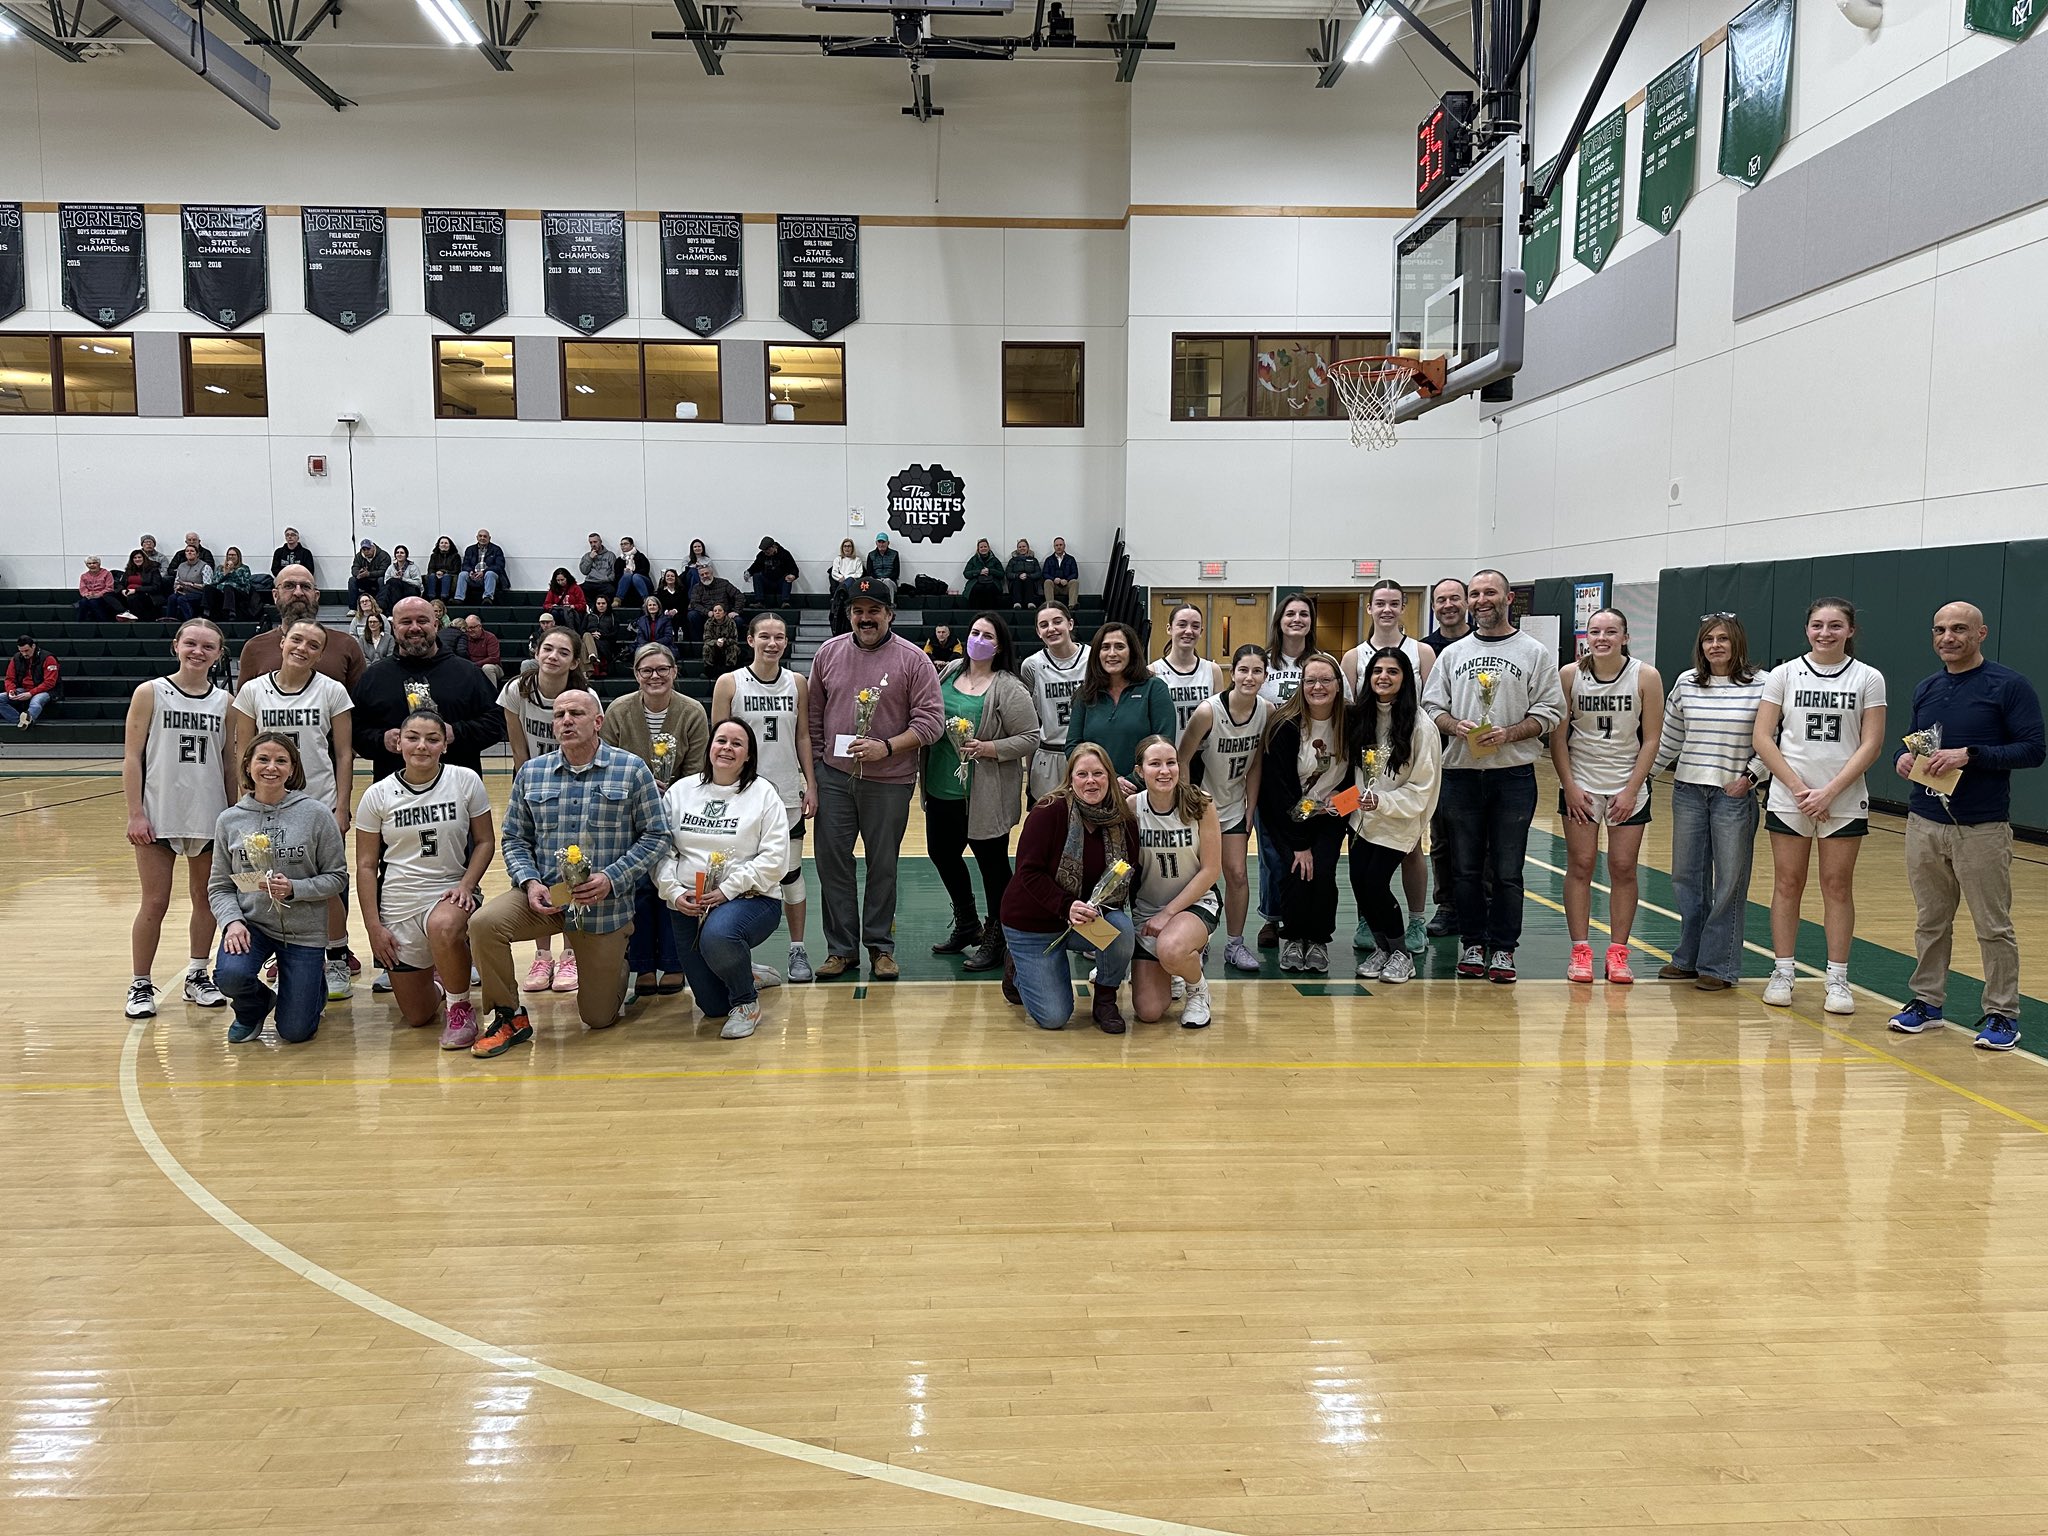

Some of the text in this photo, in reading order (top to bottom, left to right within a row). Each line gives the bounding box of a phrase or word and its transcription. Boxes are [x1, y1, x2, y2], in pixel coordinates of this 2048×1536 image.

[1653, 111, 1688, 141] CHAMPIONS
[1659, 105, 1683, 128] LEAGUE
[1586, 162, 1615, 188] CHAMPIONS
[1590, 156, 1610, 176] LEAGUE
[62, 211, 142, 229] HORNETS
[183, 213, 263, 231] HORNETS
[305, 214, 384, 233] HORNETS
[425, 216, 504, 234] HORNETS
[545, 219, 622, 236] HORNETS
[662, 220, 740, 238] HORNETS
[780, 222, 856, 241] HORNETS
[901, 485, 931, 497] The
[893, 498, 961, 511] HORNETS
[905, 512, 950, 525] NEST
[1455, 657, 1522, 680] MANCHESTER
[1170, 686, 1209, 701] ORNETS
[1578, 694, 1632, 712] HORNETS
[1794, 690, 1856, 710] HORNETS
[744, 695, 794, 713] HORNETS
[164, 710, 221, 733] HORNETS
[262, 709, 320, 727] HORNETS
[1596, 715, 1613, 740] 4
[1805, 712, 1843, 742] 23
[763, 716, 778, 743] 3
[178, 734, 209, 764] 21
[1217, 733, 1260, 753] HORNETS
[1228, 755, 1248, 780] 12
[394, 801, 457, 828] HORNETS
[681, 812, 740, 829] HORNETS
[418, 828, 439, 858] 5
[1140, 828, 1193, 848] HORNETS
[239, 846, 304, 861] HETS
[1156, 852, 1179, 878] 11
